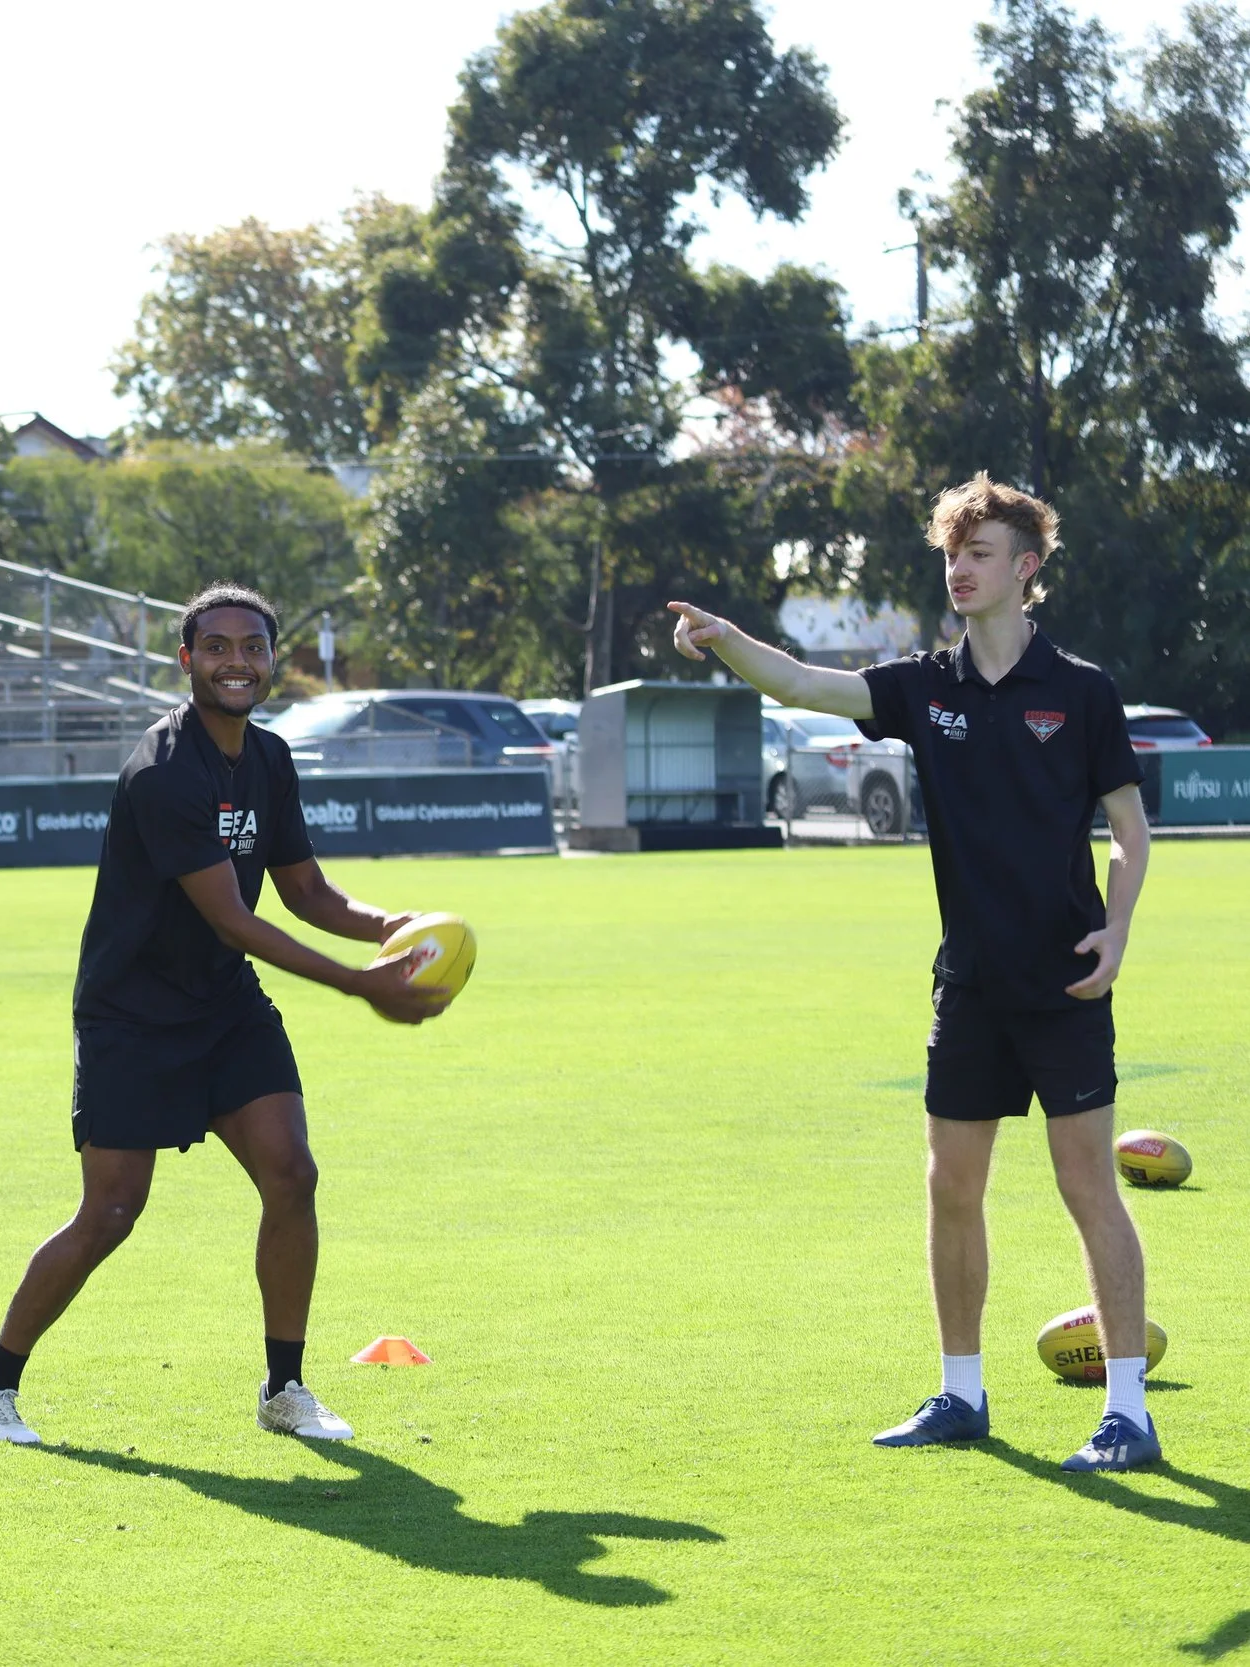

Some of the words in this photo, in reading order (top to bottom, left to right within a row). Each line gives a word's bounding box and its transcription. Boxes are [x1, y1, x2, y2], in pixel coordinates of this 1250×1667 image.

[929, 705, 967, 729] EEA
[1174, 772, 1221, 802] FUJITSU
[304, 799, 357, 826] oalto
